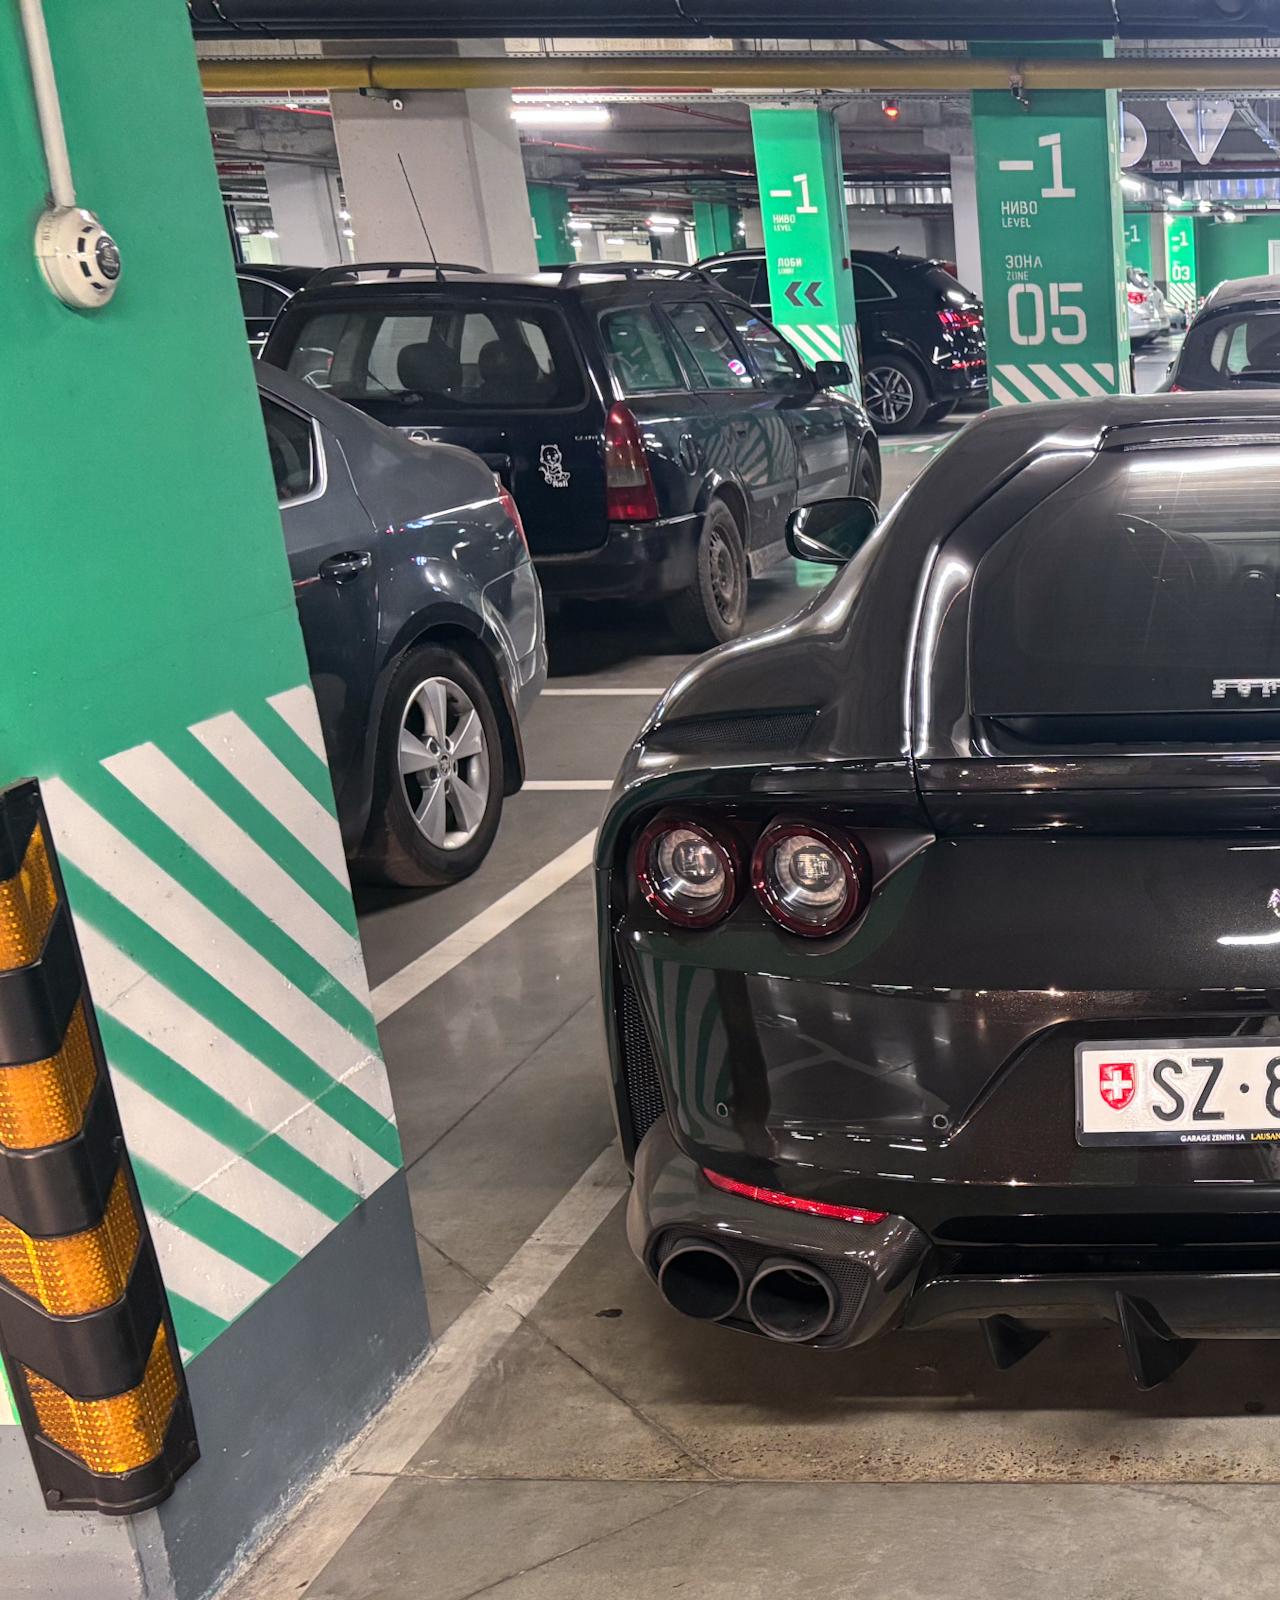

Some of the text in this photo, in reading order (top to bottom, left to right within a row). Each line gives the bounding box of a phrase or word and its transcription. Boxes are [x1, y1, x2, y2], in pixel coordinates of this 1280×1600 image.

[1001, 200, 1038, 215] НИВО
[772, 214, 796, 223] НИВО
[1002, 217, 1031, 228] LEVEL
[777, 258, 802, 267] ЛОБИ
[1005, 254, 1043, 269] ЗОНА
[1006, 271, 1029, 281] ZONE
[1172, 266, 1190, 281] 03
[1007, 282, 1088, 346] 05
[1180, 1134, 1212, 1142] GARAGE
[1236, 1133, 1246, 1141] SA
